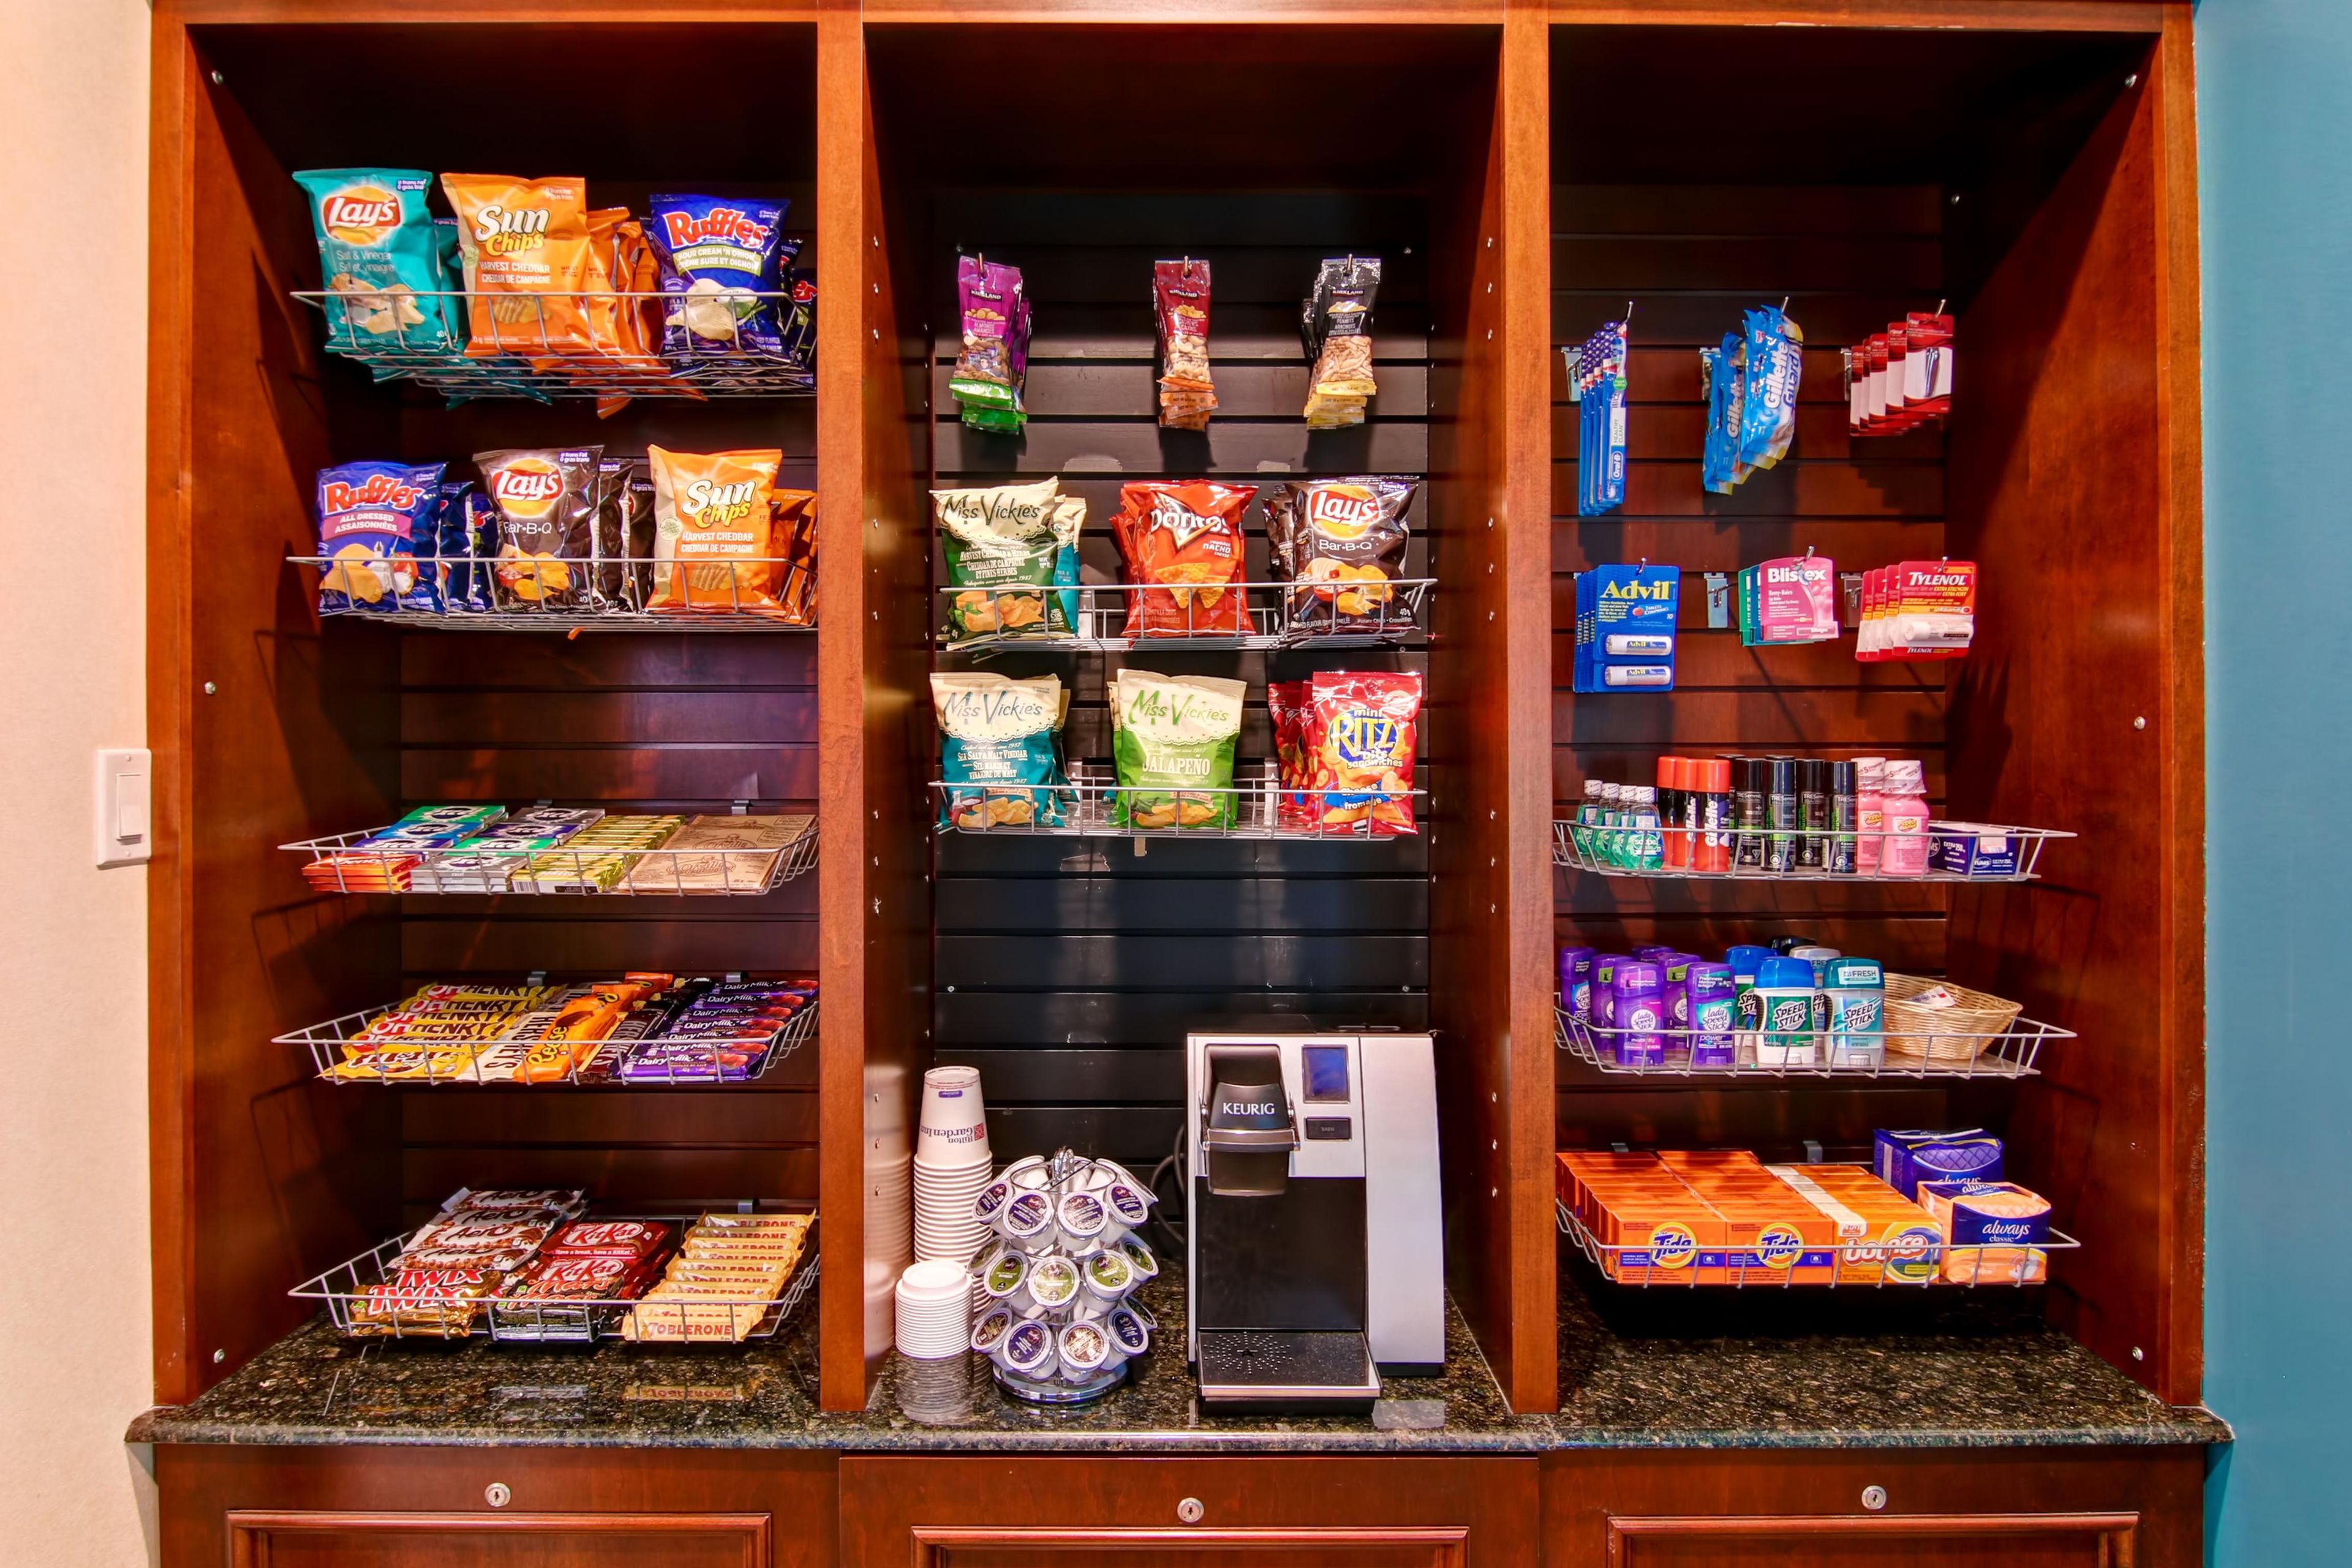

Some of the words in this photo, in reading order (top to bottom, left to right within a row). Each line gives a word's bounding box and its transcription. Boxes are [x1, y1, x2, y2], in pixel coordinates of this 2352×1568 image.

[328, 197, 398, 228] Lay's
[475, 205, 550, 242] Sun
[663, 208, 768, 249] Ruffles
[486, 233, 545, 256] Chips
[678, 250, 696, 260] SOUR
[698, 248, 722, 257] CREAM
[700, 257, 719, 266] SURE
[480, 262, 510, 271] HARVEST
[511, 262, 551, 273] CHEDDAR
[1764, 341, 1789, 409] Gillette
[1783, 353, 1800, 408] Guard
[497, 470, 560, 500] Lay's
[323, 475, 426, 515] Ruffles
[682, 480, 756, 515] Sun
[695, 502, 751, 529] Chips
[942, 494, 980, 524] Miss
[979, 492, 1041, 526] Vickie's
[1313, 492, 1378, 526] Lay's
[340, 513, 356, 523] ALL
[356, 512, 394, 522] DRESSED
[1150, 511, 1231, 535] Doritos
[335, 521, 398, 533] ASSAISONNÉES
[682, 532, 715, 541] HARVEST
[717, 532, 753, 541] CHEDDAR
[681, 544, 708, 553] CHEDDAR
[720, 545, 754, 553] CAMPAGNE
[1203, 543, 1231, 554] NACHO
[1768, 568, 1827, 586] Blistex
[1909, 572, 1967, 586] TYLENOL
[1599, 580, 1670, 600] Advil
[944, 692, 981, 726] Miss
[983, 690, 1042, 725] Vickie's
[1128, 690, 1167, 725] Miss
[1170, 694, 1230, 726] Vickie's
[1354, 709, 1383, 718] mini
[1330, 715, 1396, 758] RITZ
[1142, 754, 1211, 775] JALAPEÑO
[1348, 757, 1403, 769] sandwiches
[707, 995, 733, 1004] Dairy
[693, 1008, 719, 1017] Dairy
[1707, 1008, 1724, 1019] lady
[1774, 1001, 1805, 1019] SPEED
[1845, 1004, 1873, 1019] SPEED
[684, 1020, 712, 1030] Dairy
[1634, 1018, 1654, 1027] Speed
[1703, 1014, 1727, 1026] Speed
[1708, 1022, 1727, 1031] Stick
[1778, 1012, 1805, 1029] STICK
[1848, 1015, 1874, 1028] STICK
[638, 1057, 667, 1066] Dairy
[1223, 1102, 1275, 1115] KEURIG
[921, 1125, 932, 1137] Inn
[933, 1127, 973, 1138] Garden
[948, 1135, 973, 1144] Hilton
[1983, 1219, 2030, 1236] always
[1653, 1233, 1692, 1260] Tide
[1761, 1233, 1799, 1261] Tide
[398, 1270, 486, 1287] TWIX
[649, 1322, 733, 1336] TOBLERONE
